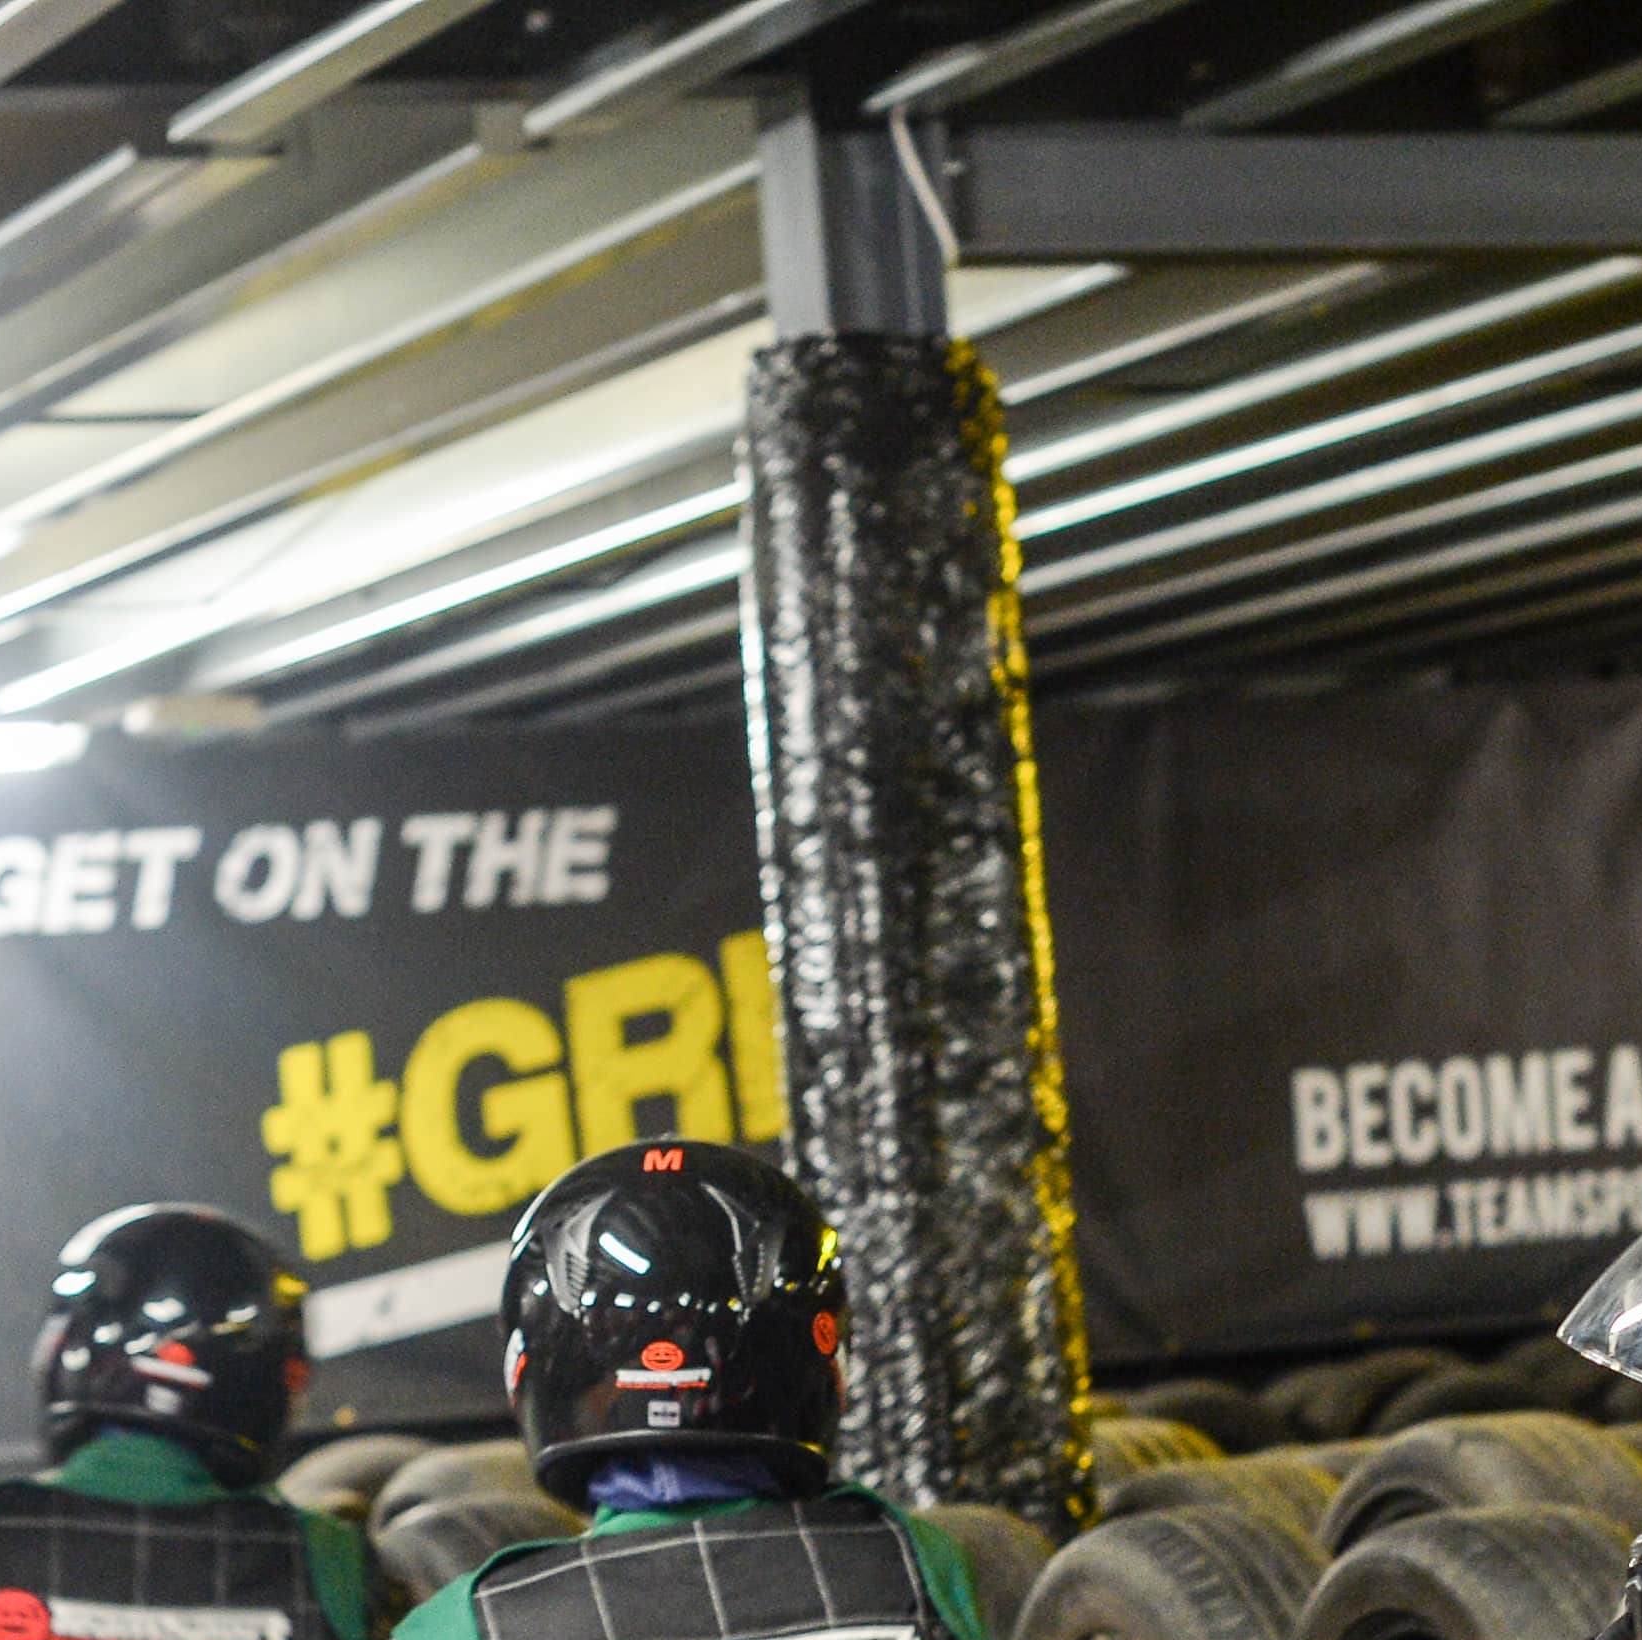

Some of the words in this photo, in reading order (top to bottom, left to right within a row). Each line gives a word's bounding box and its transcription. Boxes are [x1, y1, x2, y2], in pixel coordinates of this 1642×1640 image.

[215, 817, 381, 924] ON
[400, 804, 618, 913] THE
[642, 1147, 685, 1173] M
[1291, 1046, 1599, 1174] BECOME
